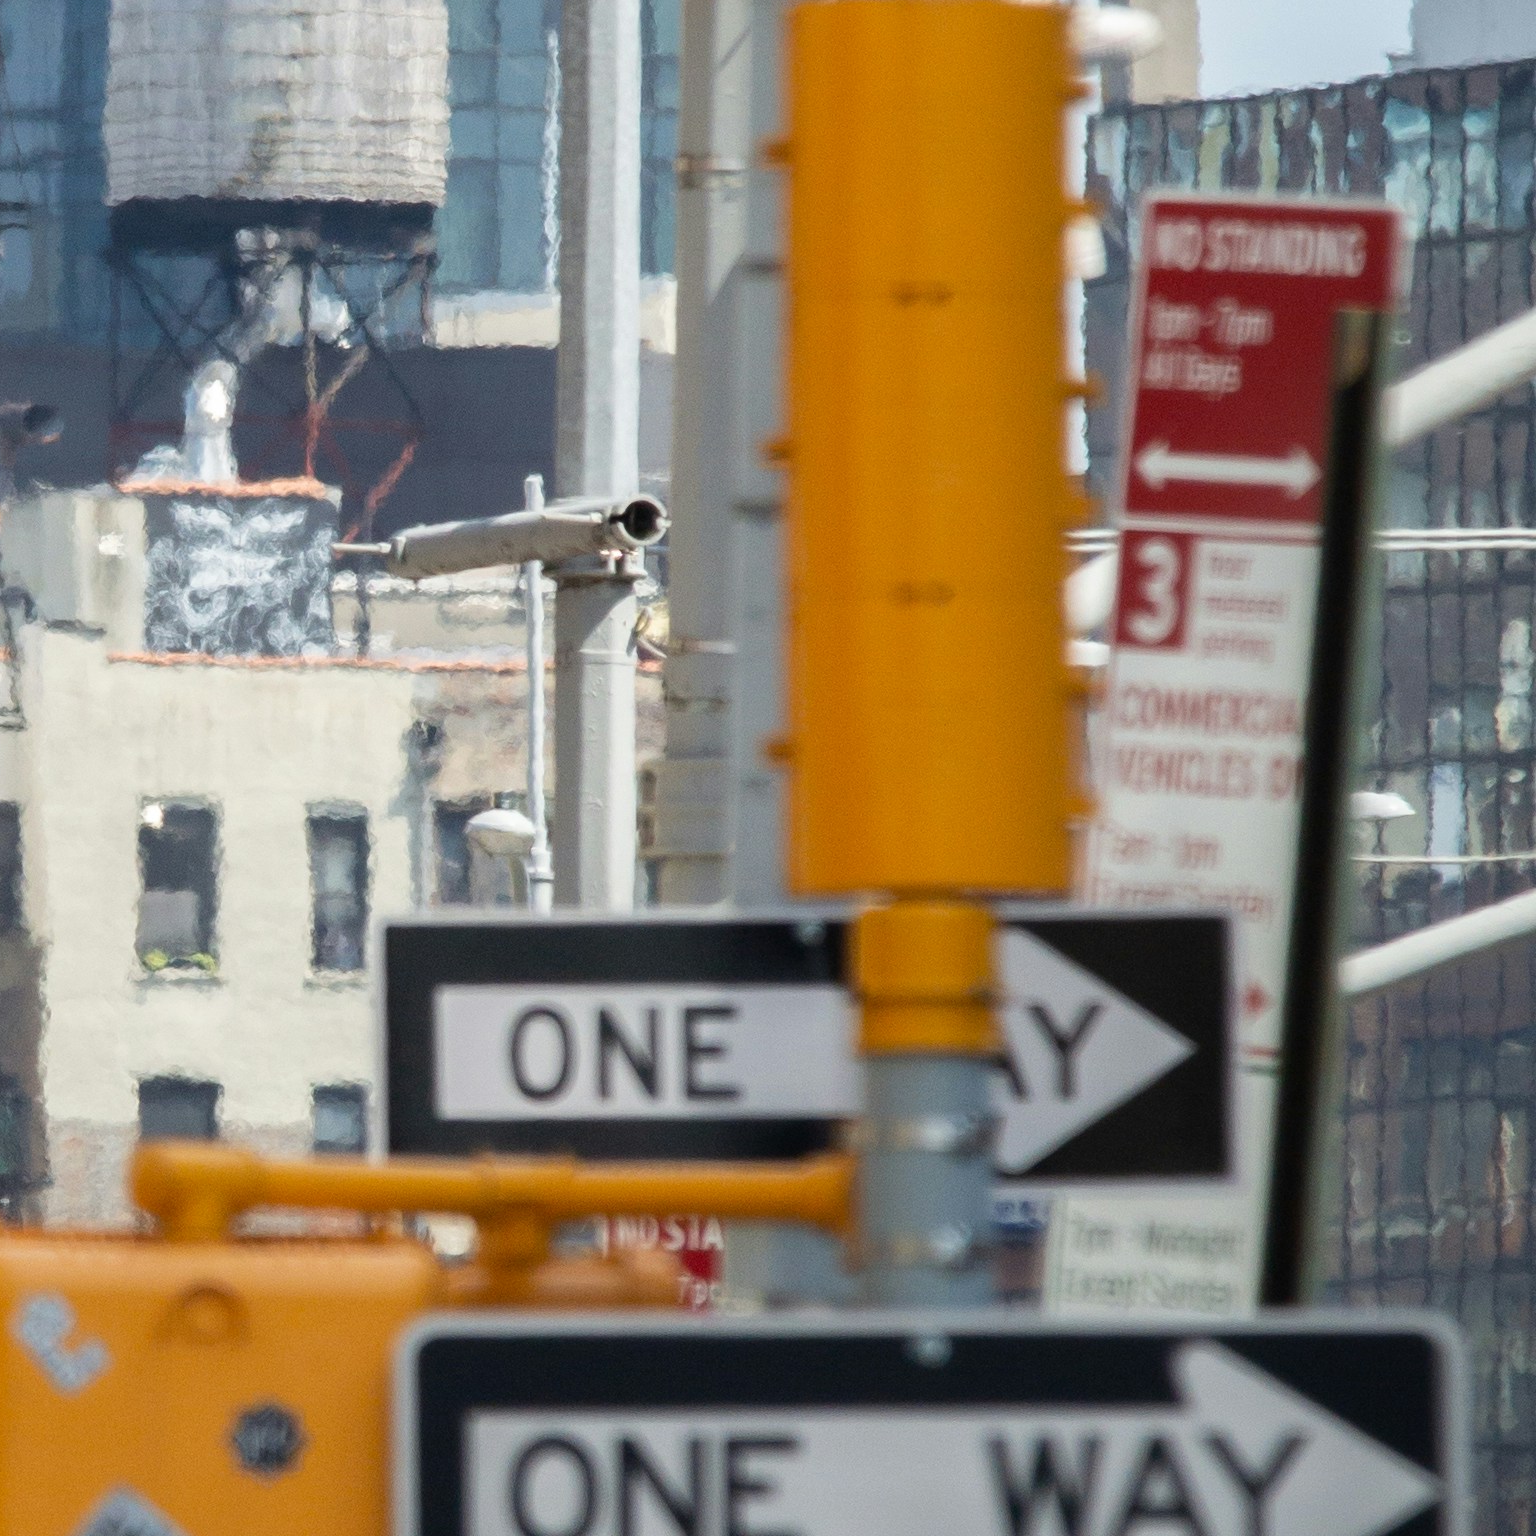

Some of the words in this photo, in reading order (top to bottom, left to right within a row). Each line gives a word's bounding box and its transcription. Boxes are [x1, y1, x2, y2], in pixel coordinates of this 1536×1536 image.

[1204, 220, 1366, 279] STANDING
[1128, 536, 1182, 645] 3
[507, 1002, 742, 1102] ONE
